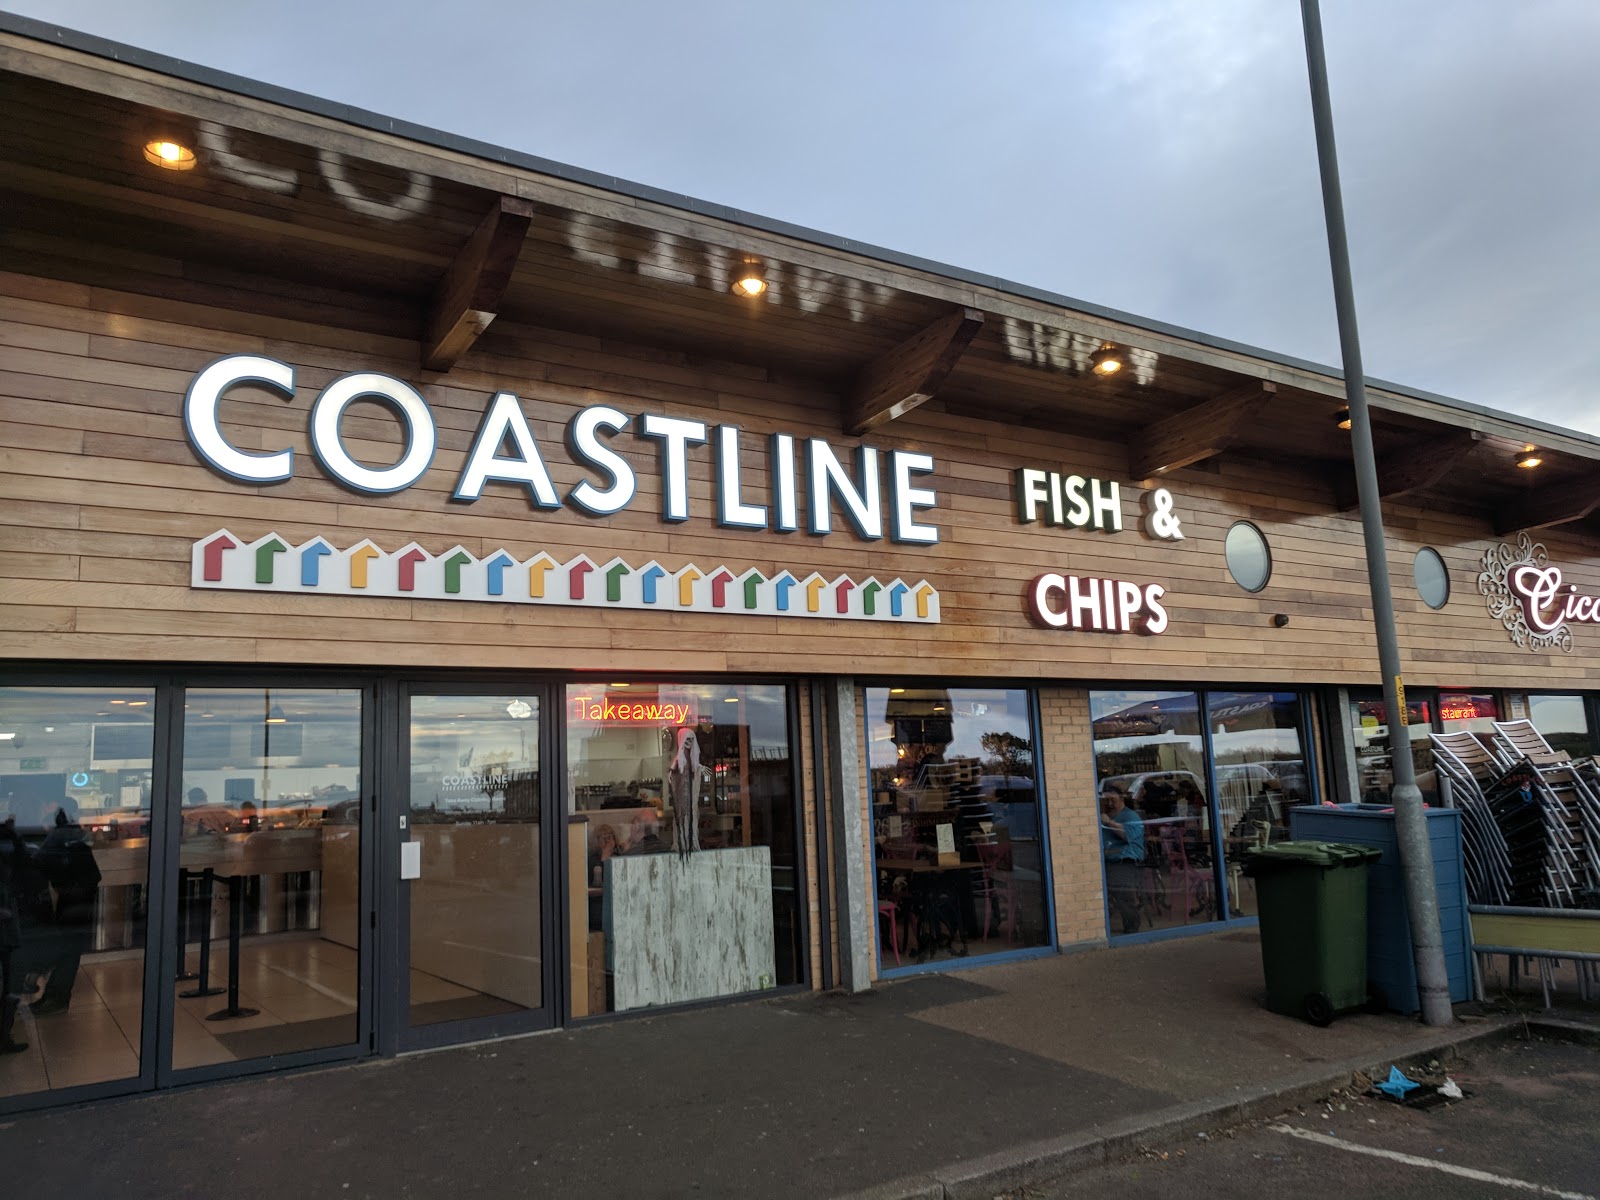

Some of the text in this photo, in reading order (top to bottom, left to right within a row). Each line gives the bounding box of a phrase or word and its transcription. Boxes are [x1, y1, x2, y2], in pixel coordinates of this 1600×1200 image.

[184, 354, 939, 544] COASTLINE
[1017, 467, 1186, 542] FISH &
[1029, 572, 1169, 635] CHIPS
[574, 696, 690, 724] Takeaway
[442, 774, 508, 786] COASTLINE
